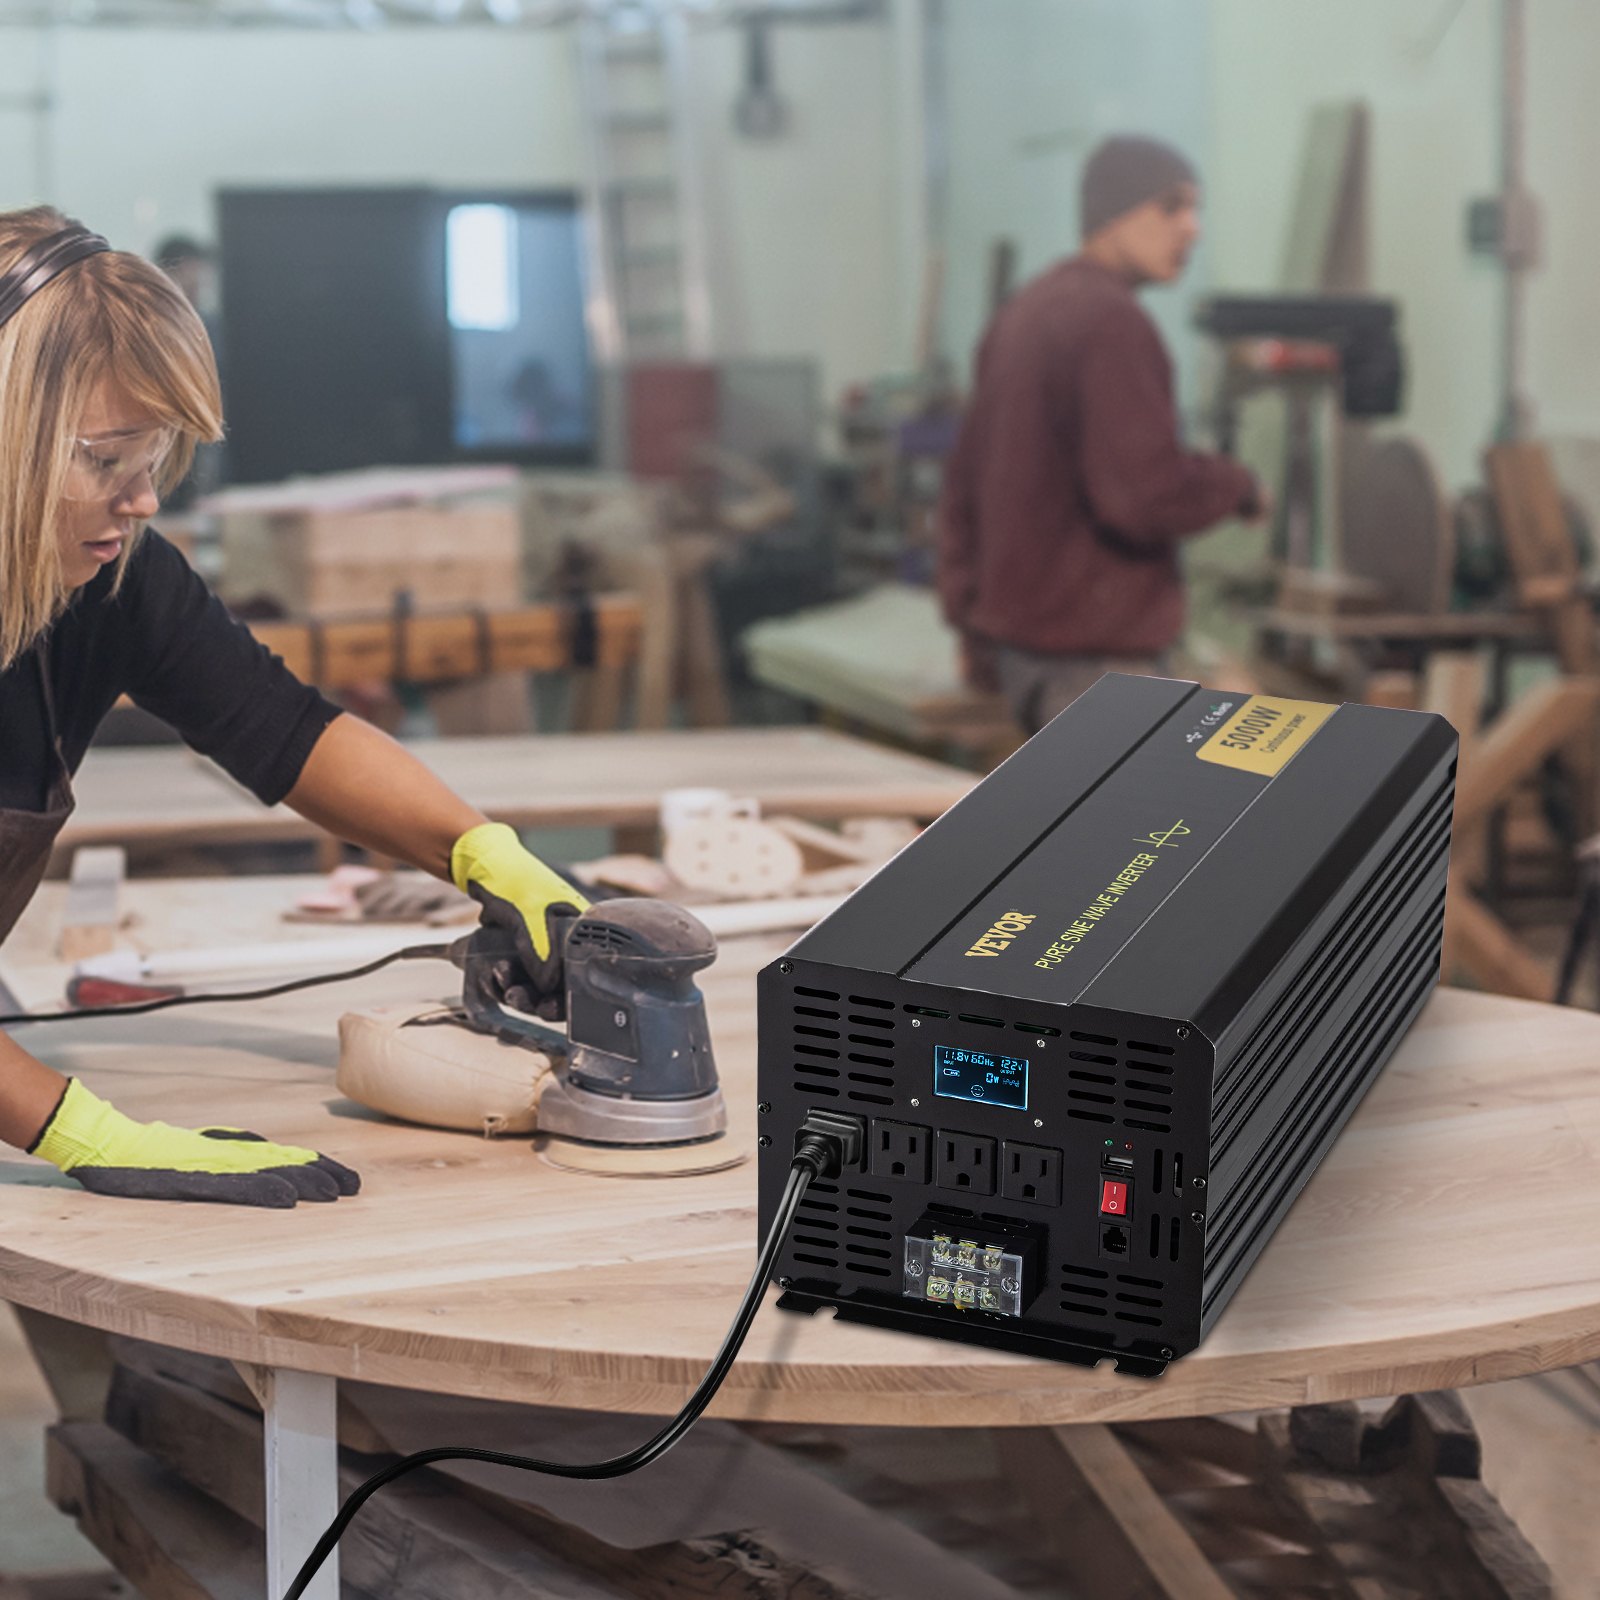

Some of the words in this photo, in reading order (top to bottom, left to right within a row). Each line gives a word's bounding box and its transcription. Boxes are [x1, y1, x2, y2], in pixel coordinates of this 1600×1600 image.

[1220, 705, 1282, 750] 5000W
[1034, 941, 1074, 970] PURE
[1061, 920, 1094, 943] SINE
[1080, 894, 1119, 921] WAVE
[1105, 853, 1158, 895] INVERTER
[965, 912, 1037, 957] VEVOR
